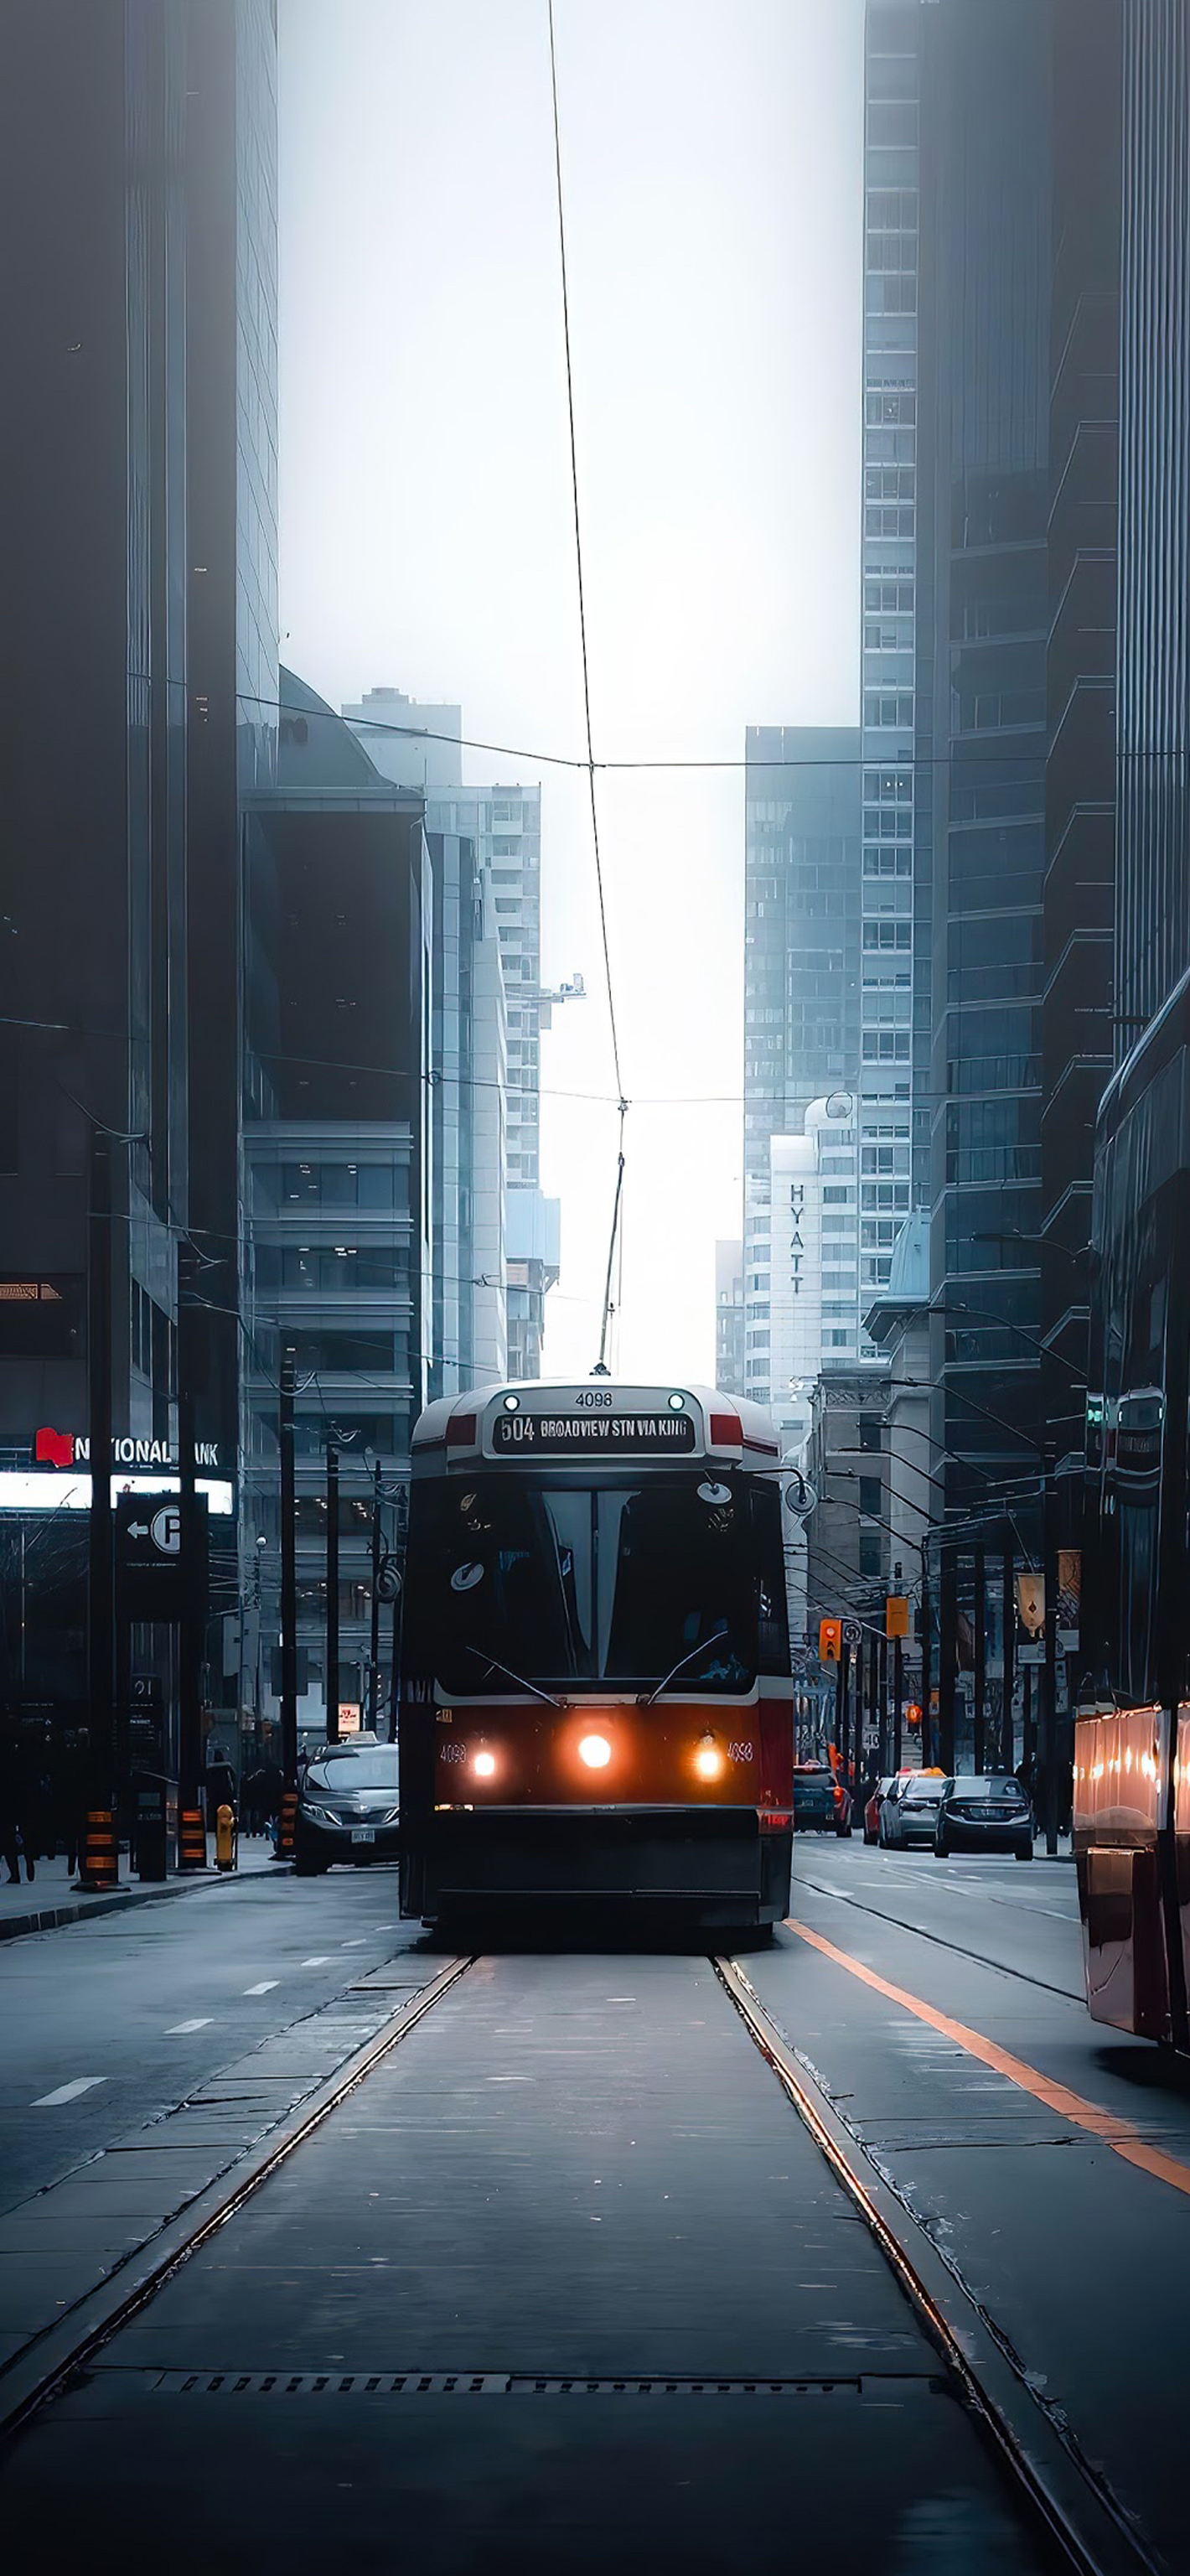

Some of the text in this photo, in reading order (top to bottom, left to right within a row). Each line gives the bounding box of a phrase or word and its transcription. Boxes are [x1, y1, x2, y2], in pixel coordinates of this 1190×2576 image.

[790, 1184, 805, 1295] HYATT
[576, 1392, 613, 1407] 4098
[501, 1417, 686, 1441] 504 BROADVIEW STN VIA KING
[75, 1436, 172, 1464] NIONAL
